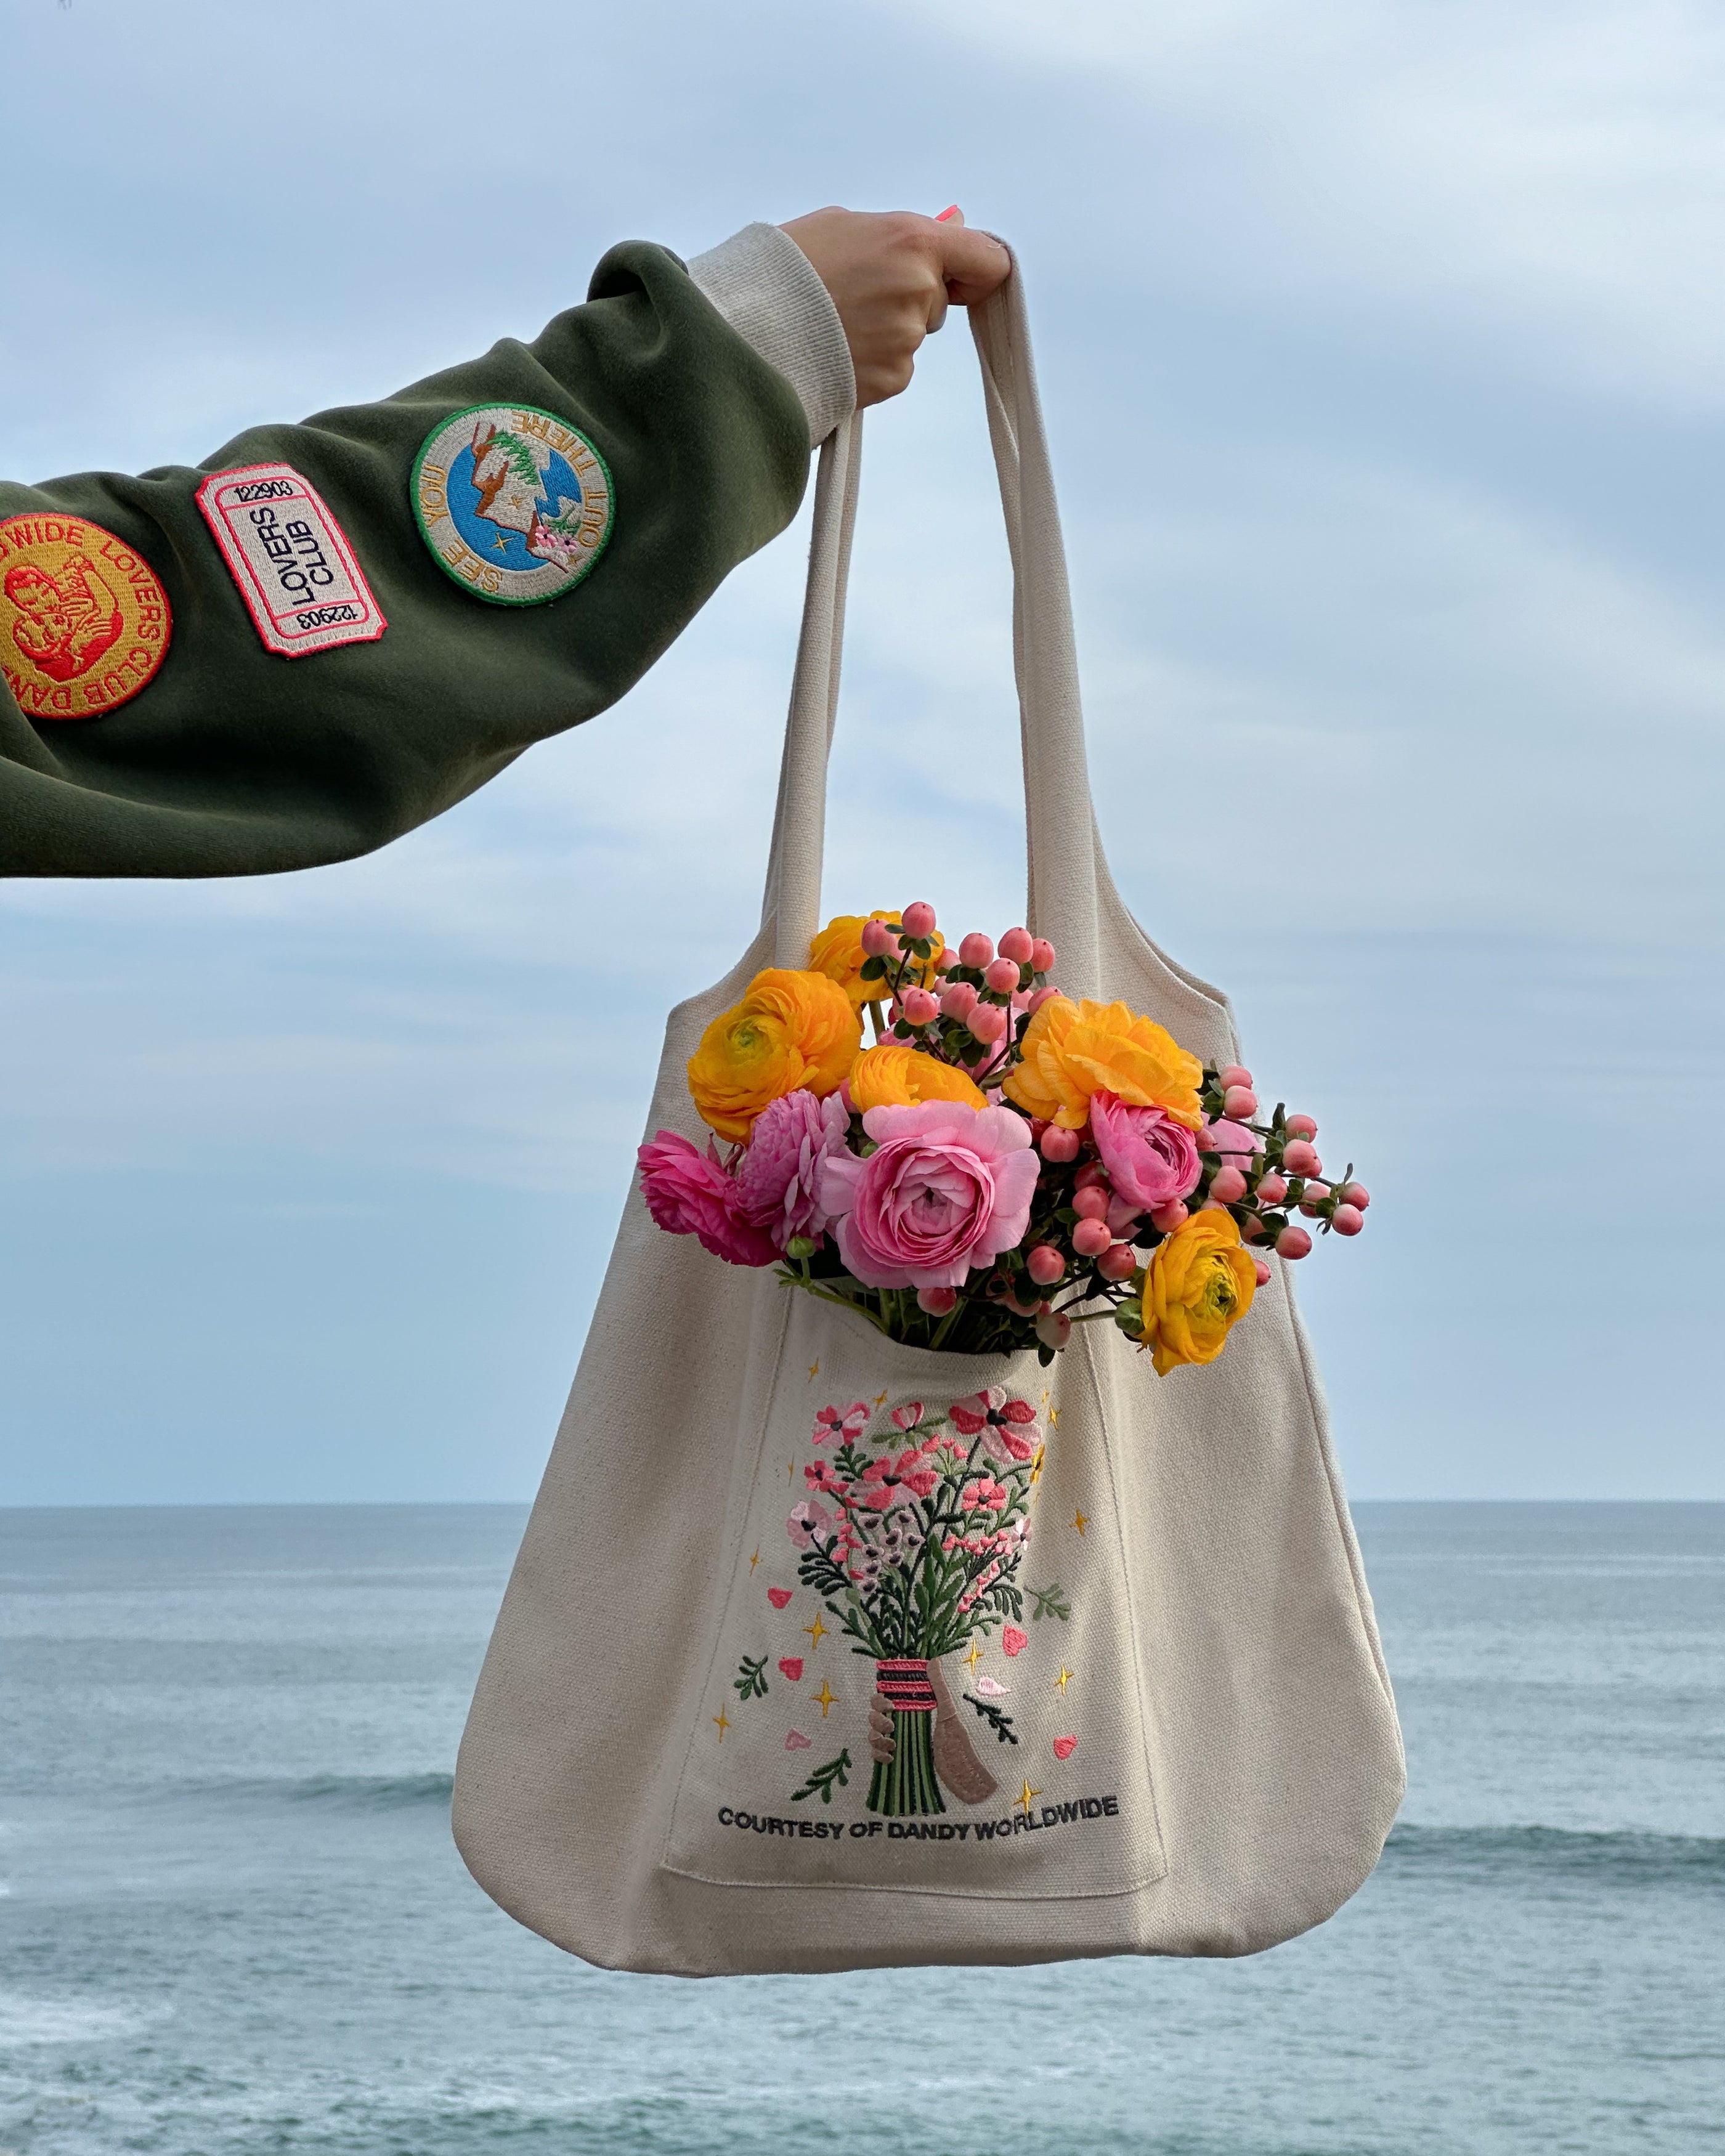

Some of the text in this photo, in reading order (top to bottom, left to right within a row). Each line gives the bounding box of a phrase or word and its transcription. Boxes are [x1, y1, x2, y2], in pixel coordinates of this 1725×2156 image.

[233, 480, 293, 502] 122903
[511, 411, 607, 548] OUT THERE
[250, 507, 315, 606] LOVERS
[286, 521, 334, 585] CLUB
[421, 464, 502, 592] SEE YOU
[100, 540, 161, 641] LOVERS
[296, 605, 357, 630] 122903
[1, 666, 71, 710] DAN
[83, 648, 152, 705] CLUB
[718, 1795, 1119, 1841] COURTESY OF DANDY WORLDWIDE
